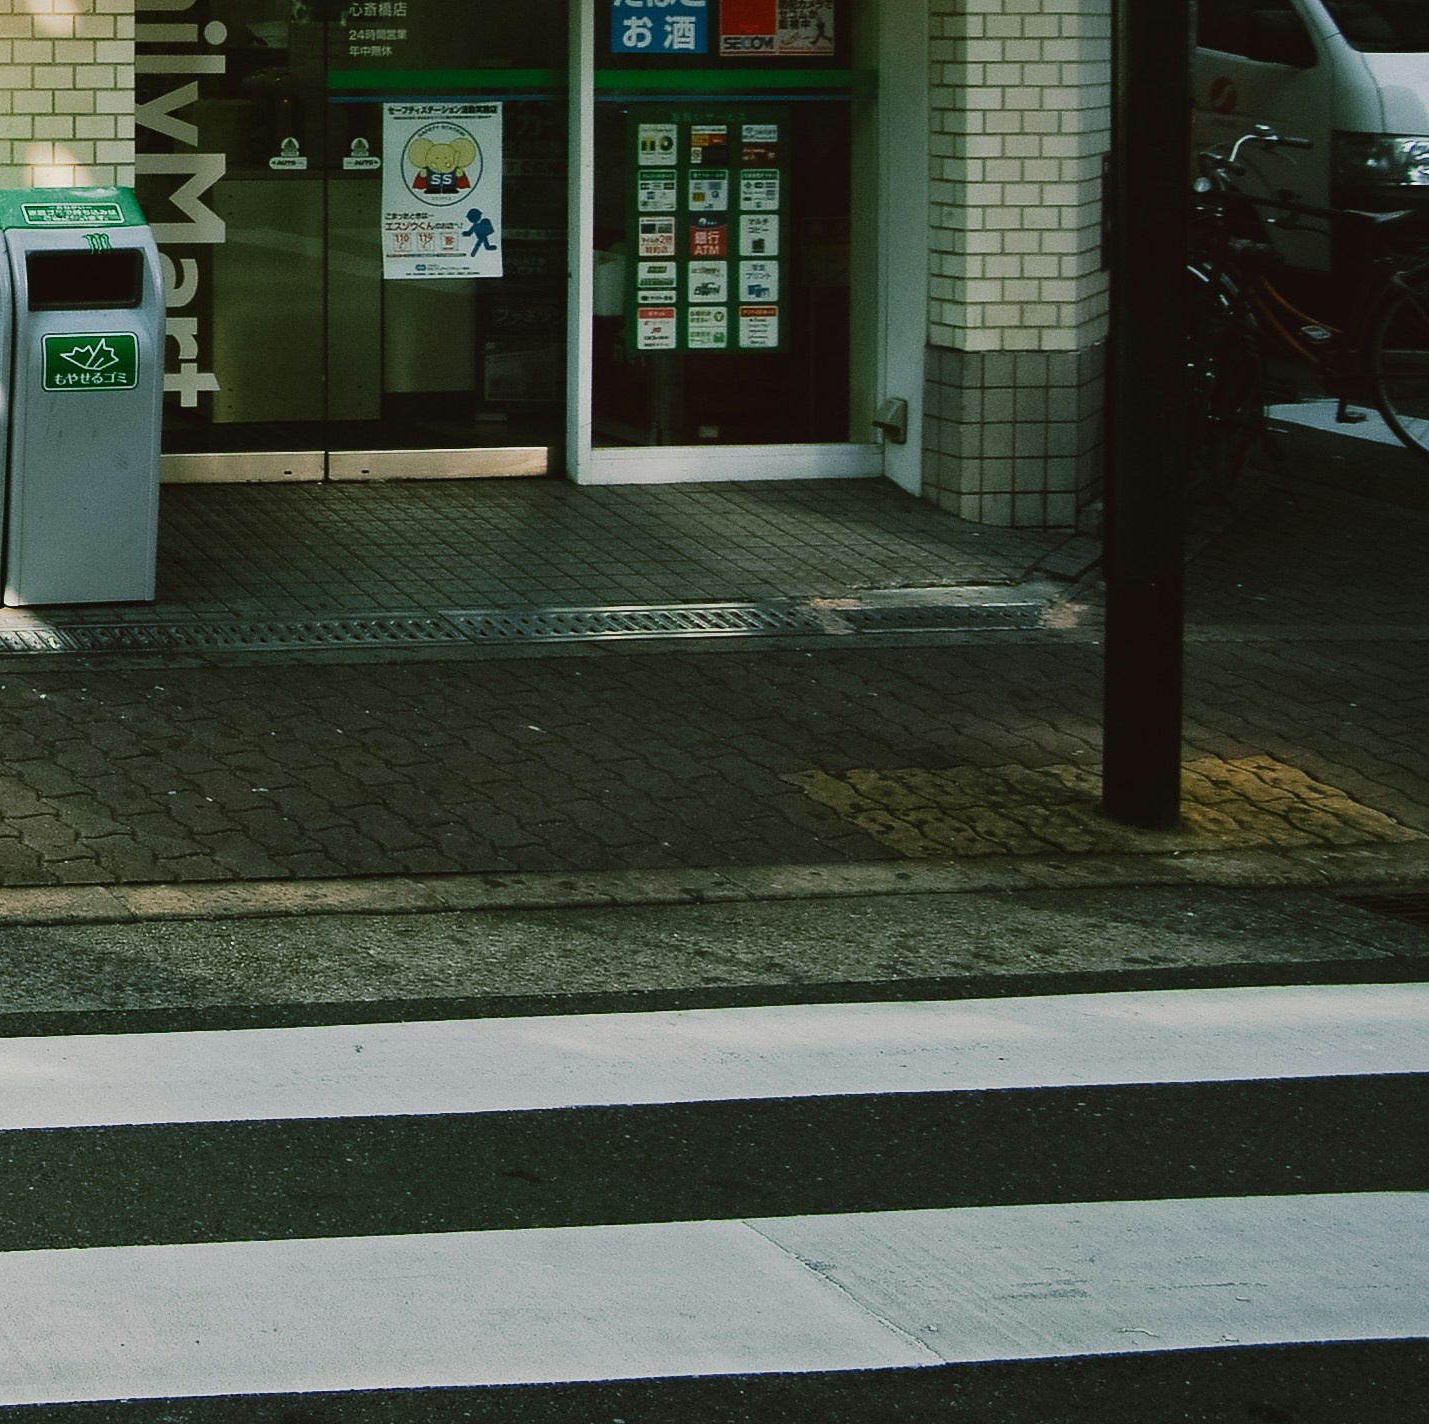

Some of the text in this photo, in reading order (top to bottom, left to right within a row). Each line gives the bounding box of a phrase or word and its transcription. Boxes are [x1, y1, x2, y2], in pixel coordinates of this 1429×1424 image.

[348, 2, 407, 17] 心斎橋店
[348, 29, 407, 40] 24時間営業
[622, 15, 696, 50] お酒
[723, 37, 774, 50] SECOM
[348, 45, 393, 56] 年中無休
[430, 174, 453, 185] SS
[694, 231, 721, 245] 銀行
[694, 245, 720, 255] ATM
[53, 372, 128, 386] もやせるゴミ
